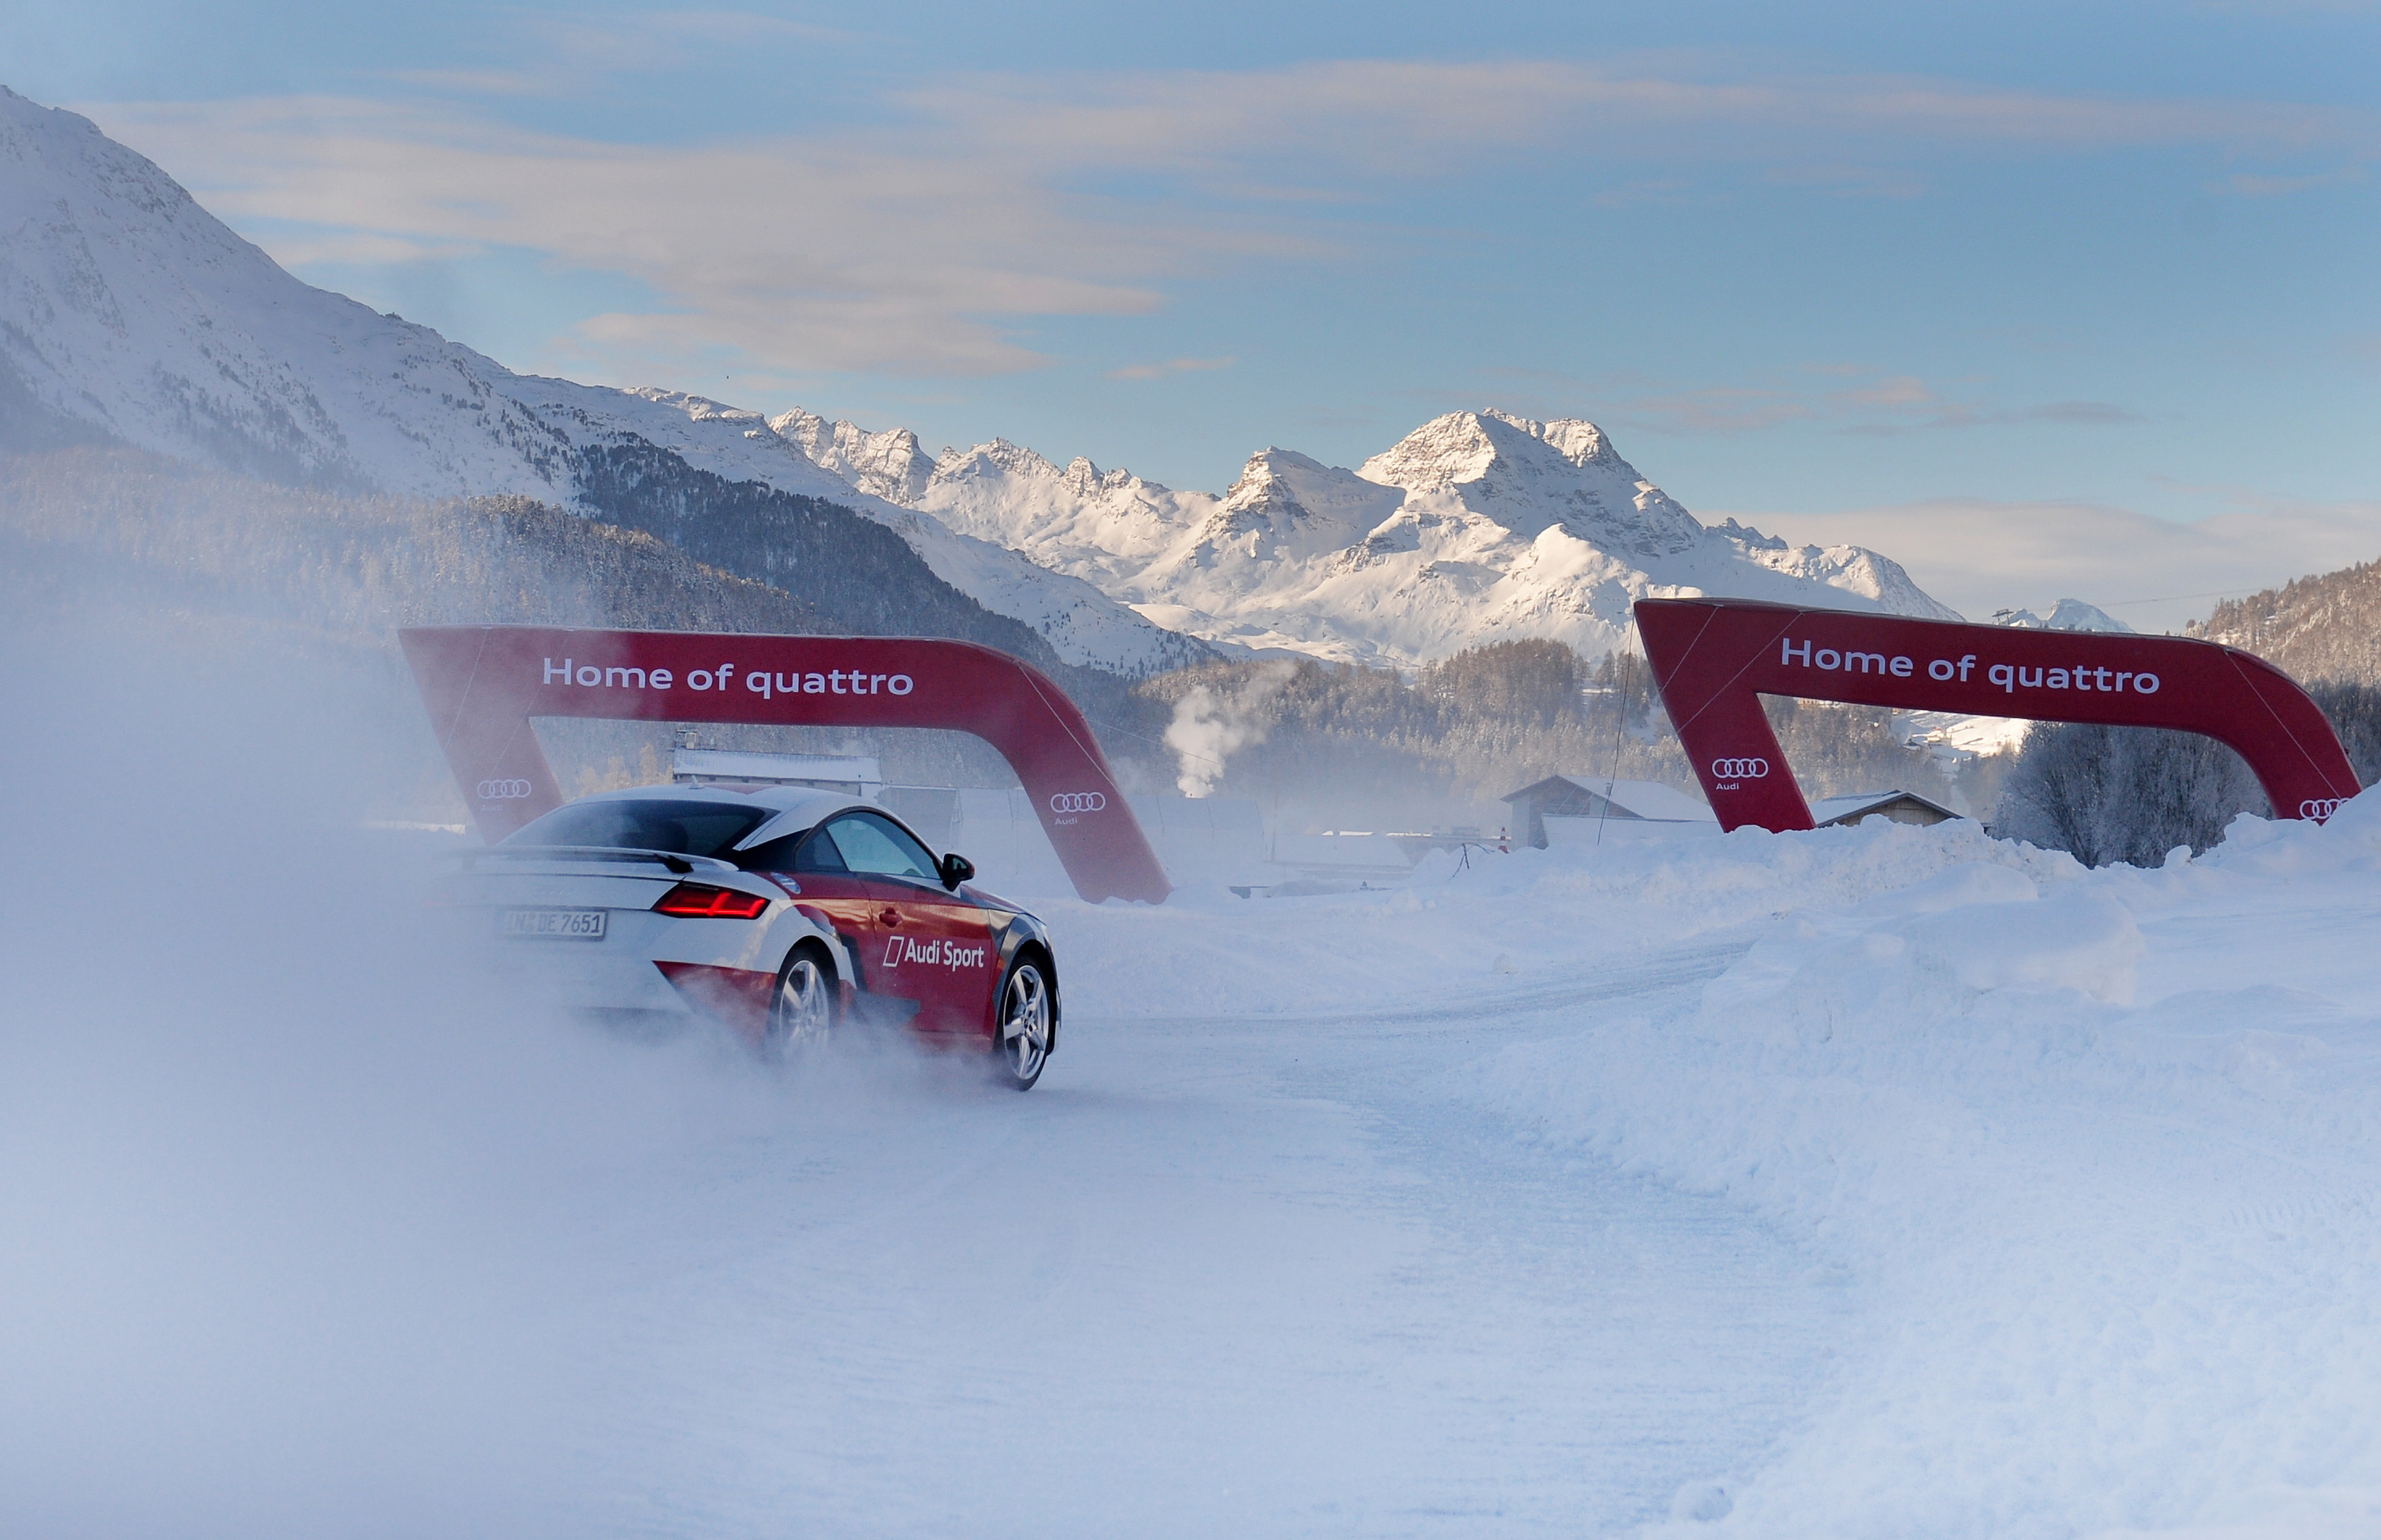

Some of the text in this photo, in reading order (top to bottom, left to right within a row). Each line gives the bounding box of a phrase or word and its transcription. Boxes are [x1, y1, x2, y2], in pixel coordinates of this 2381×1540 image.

[543, 656, 914, 700] Home of quattro
[1782, 638, 2160, 694] Home of quattro
[1715, 782, 1740, 791] Audi
[1054, 816, 1078, 825] Audi
[537, 914, 557, 933] DE
[561, 914, 600, 934] 7651
[903, 937, 985, 973] Audi Sport
